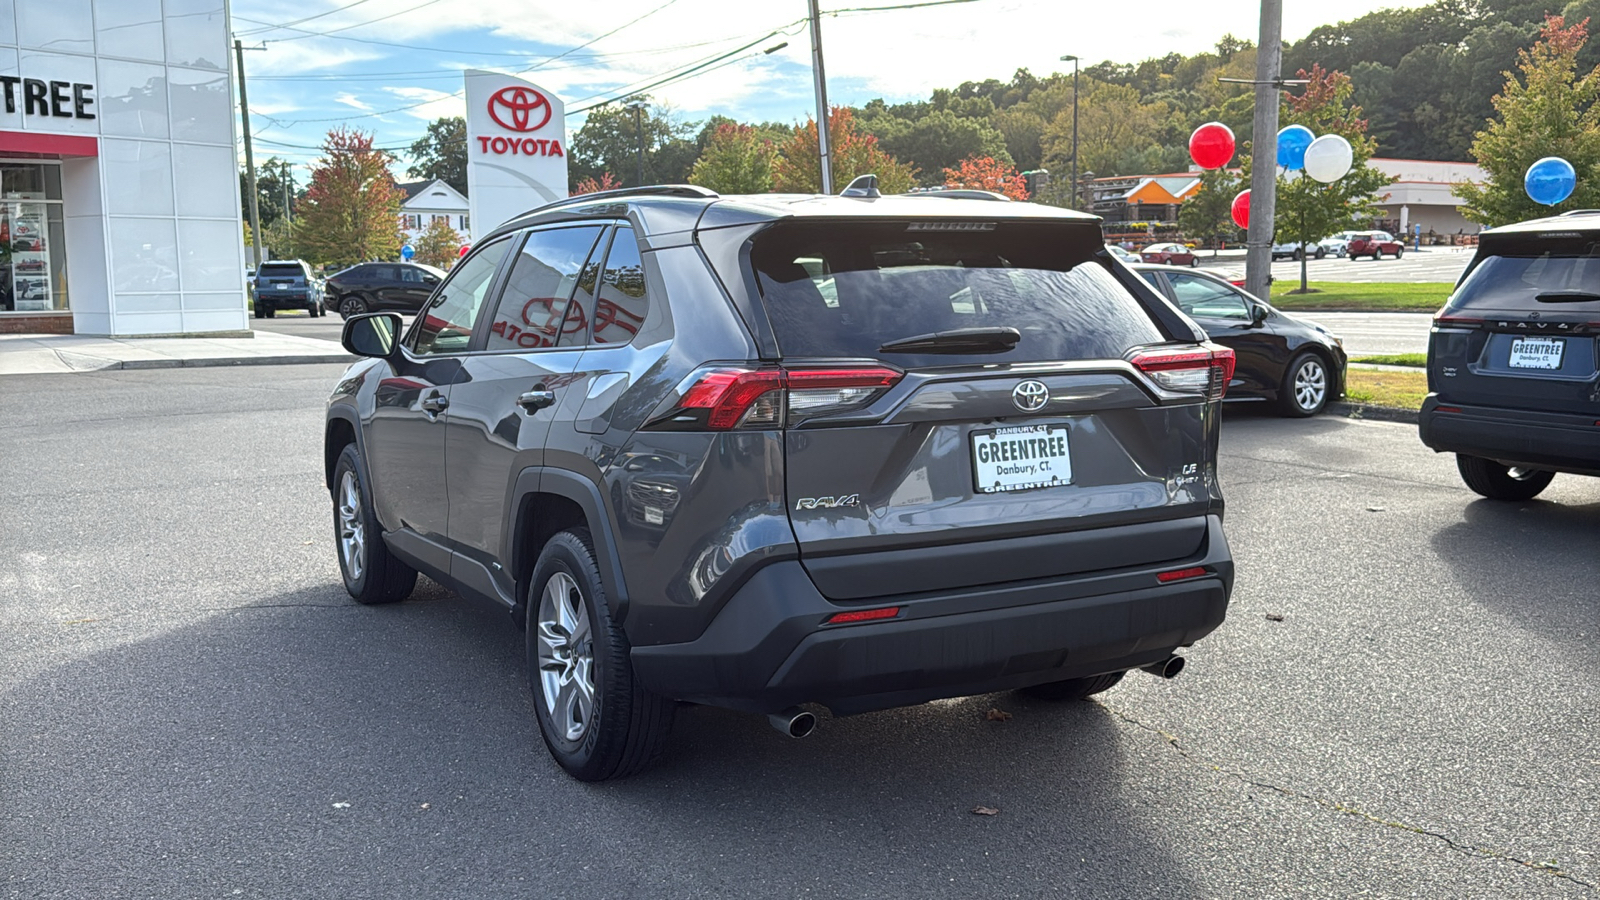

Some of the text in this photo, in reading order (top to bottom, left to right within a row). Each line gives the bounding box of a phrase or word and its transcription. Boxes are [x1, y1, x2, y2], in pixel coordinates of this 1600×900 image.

[0, 75, 96, 120] TREE
[477, 135, 564, 158] TOYOTA
[1498, 321, 1569, 329] RAV4
[1513, 343, 1561, 356] GREENTREE
[978, 436, 1066, 464] GREENTREE
[996, 460, 1052, 476] Danbury, CT.
[1182, 463, 1198, 475] LE
[984, 478, 1071, 493] GREENTREE
[795, 493, 861, 511] RAV4
